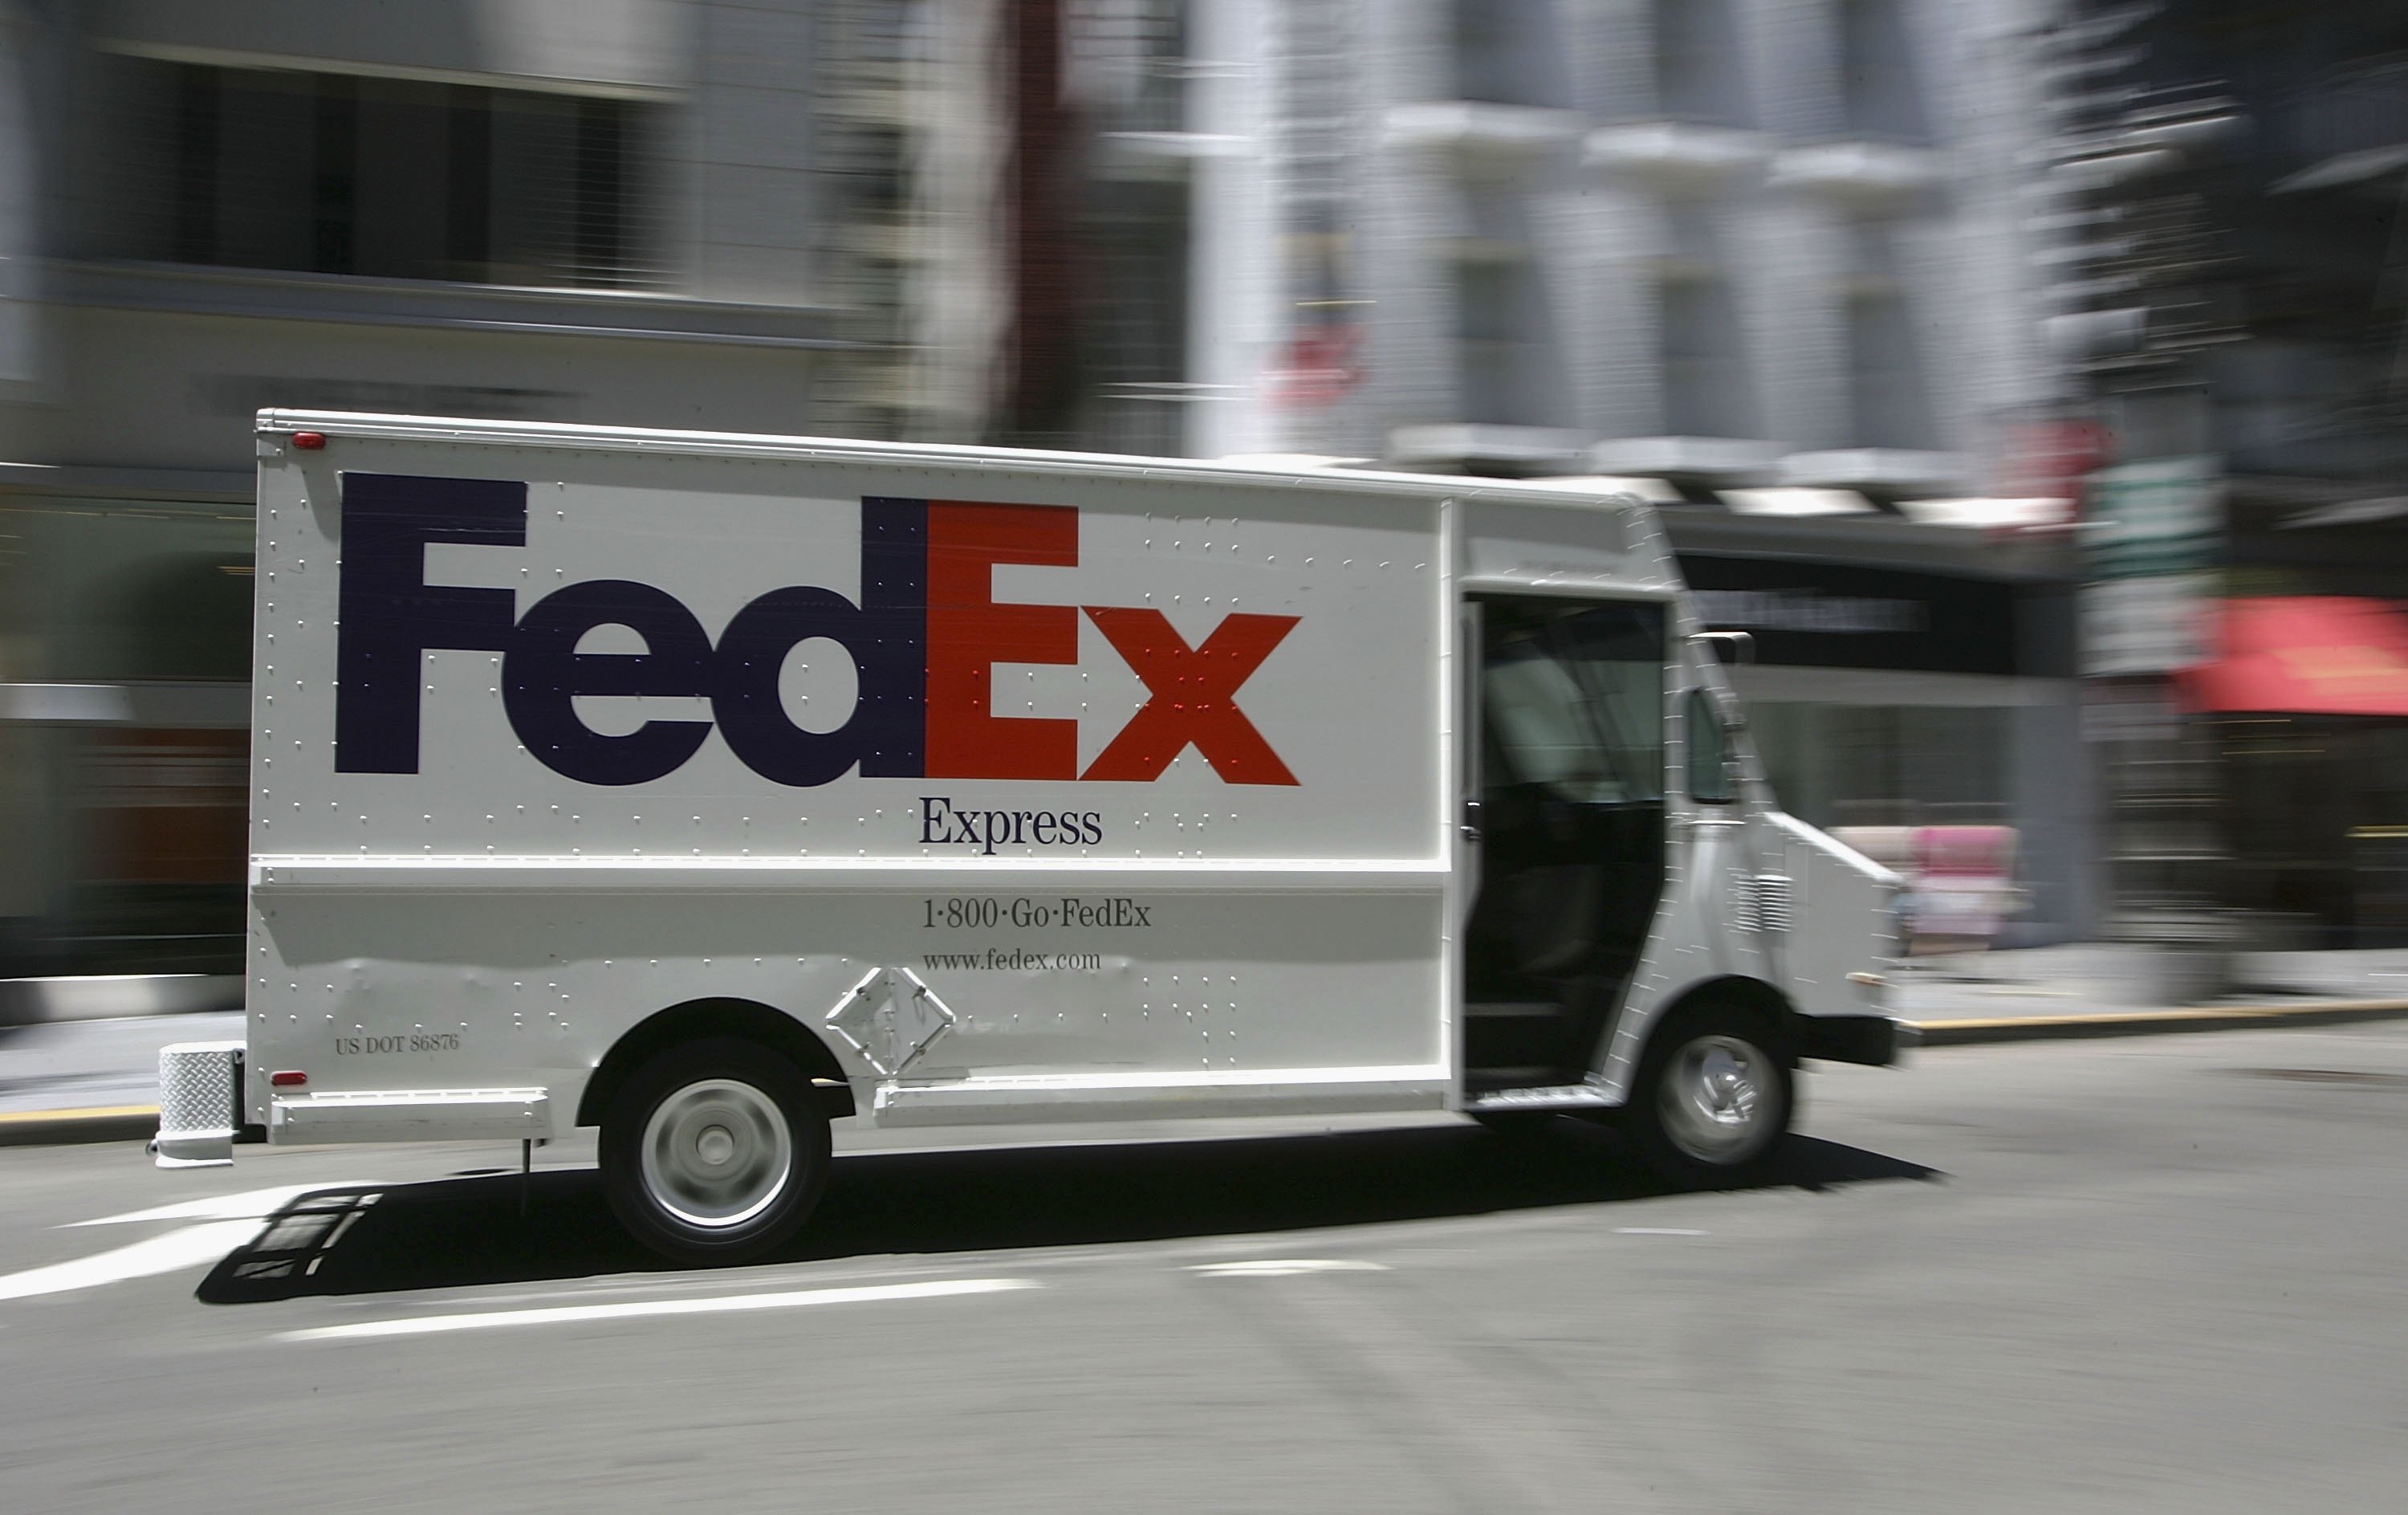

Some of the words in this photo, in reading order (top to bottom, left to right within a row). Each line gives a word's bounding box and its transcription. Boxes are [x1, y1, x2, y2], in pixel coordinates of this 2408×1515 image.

[335, 472, 1302, 787] FedEx
[919, 796, 1103, 856] Express
[923, 947, 1101, 971] www.fedex.com
[336, 1037, 360, 1056] US
[366, 1036, 405, 1054] DOT
[409, 1033, 460, 1053] 86876
